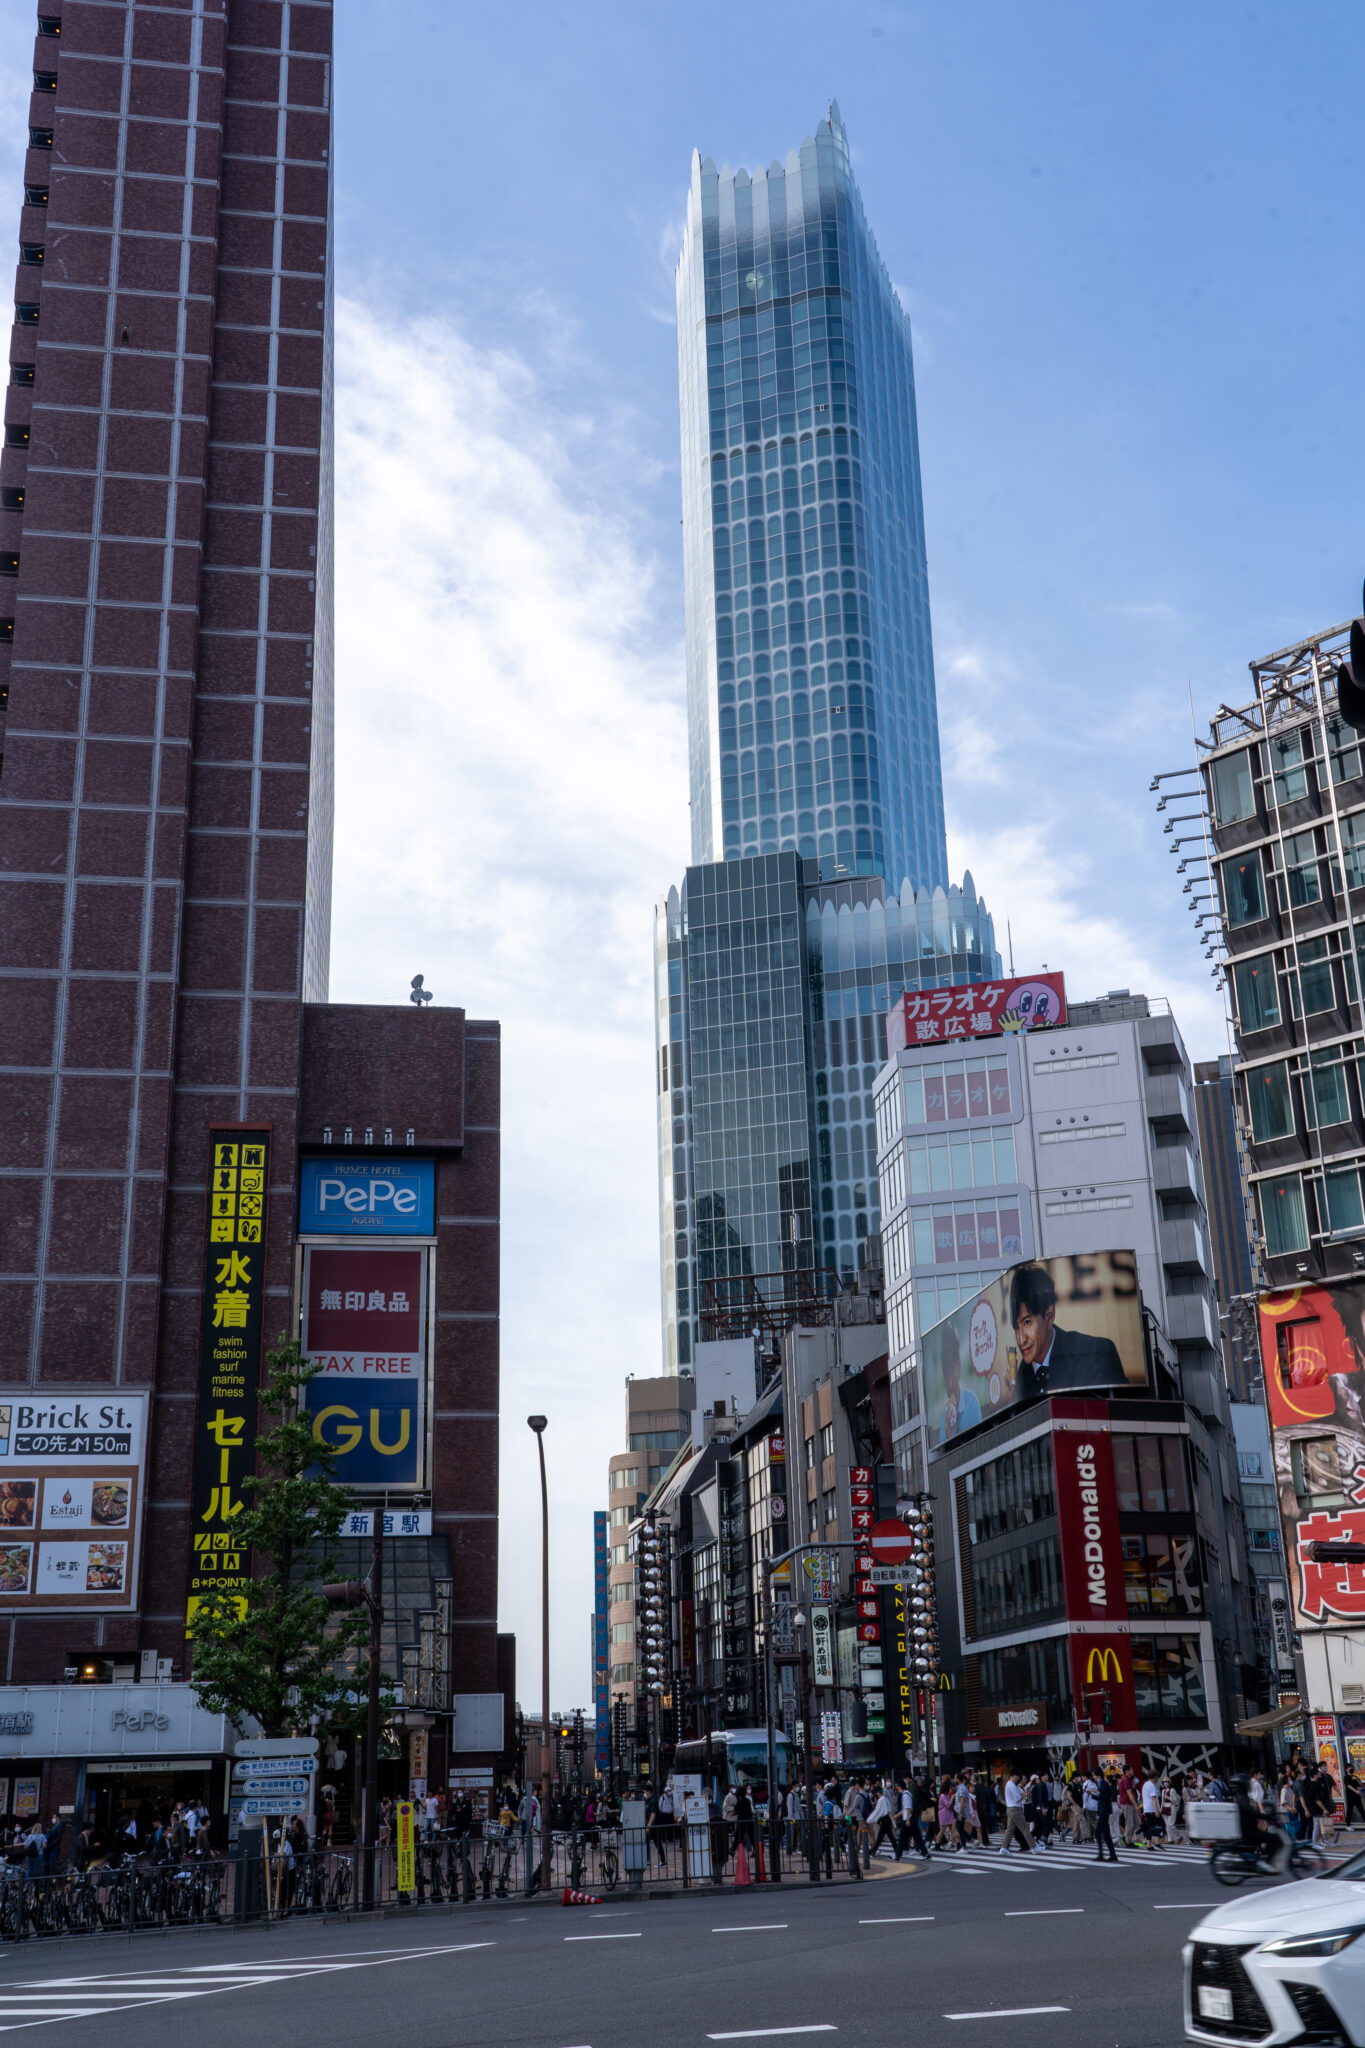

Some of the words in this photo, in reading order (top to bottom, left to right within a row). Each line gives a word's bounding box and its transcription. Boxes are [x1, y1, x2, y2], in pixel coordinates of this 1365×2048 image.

[907, 984, 1005, 1020] カラオケ
[916, 1011, 992, 1040] 歌広場
[928, 1082, 1008, 1108] カラオケ
[335, 1166, 368, 1175] PRINCE
[371, 1166, 402, 1175] HOTEL
[319, 1179, 417, 1213] PePe
[936, 1226, 997, 1248] 歌広場
[212, 1250, 251, 1329] 水着
[319, 1288, 410, 1313] 無印良品
[218, 1336, 243, 1347] swim
[212, 1347, 248, 1360] fashion
[219, 1360, 240, 1372] surf
[314, 1356, 354, 1373] TAX
[363, 1357, 411, 1374] FREE
[212, 1373, 245, 1385] marine
[212, 1386, 245, 1398] fitness
[17, 1404, 89, 1429] Brick
[98, 1405, 133, 1429] St.
[311, 1404, 410, 1456] GU
[16, 1435, 67, 1453] この先
[83, 1436, 128, 1453] 150m
[201, 1408, 246, 1524] セール
[49, 1505, 83, 1517] Estaji
[1077, 1443, 1108, 1606] McDonald's
[1274, 1613, 1288, 1653] 一軒め酒場
[815, 1632, 828, 1677] 一軒め酒場
[0, 1711, 33, 1729] 宿駅
[111, 1709, 169, 1731] PePe
[998, 1708, 1039, 1728] McDonald's
